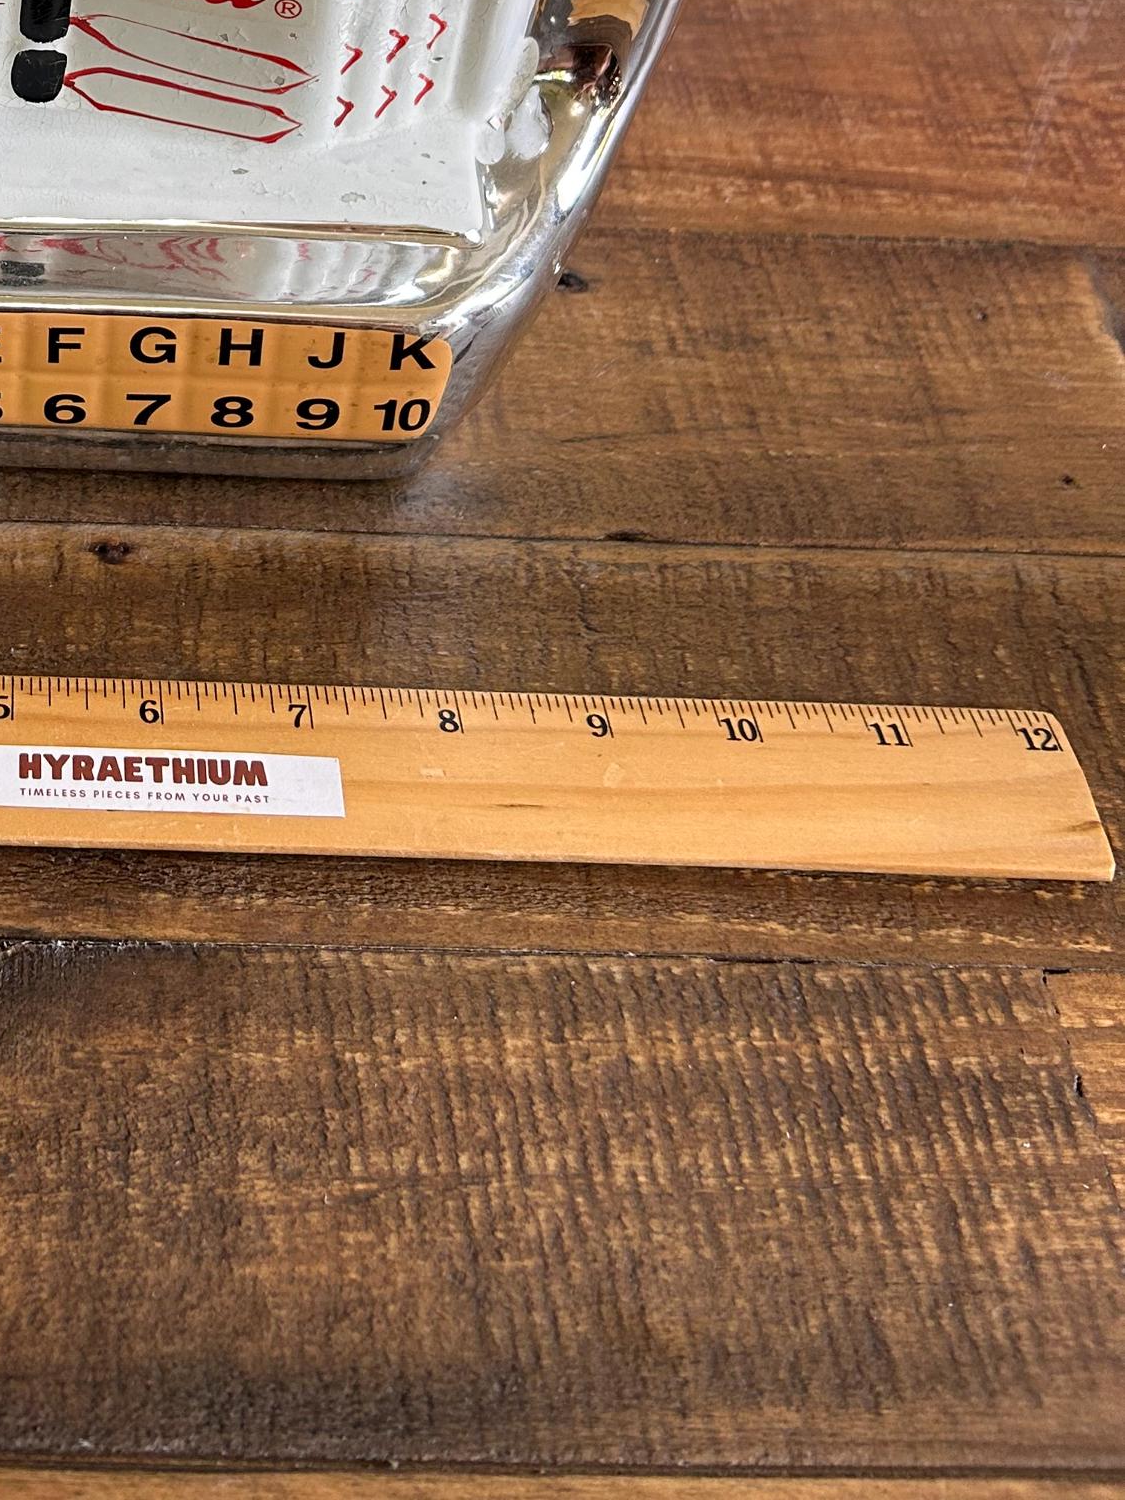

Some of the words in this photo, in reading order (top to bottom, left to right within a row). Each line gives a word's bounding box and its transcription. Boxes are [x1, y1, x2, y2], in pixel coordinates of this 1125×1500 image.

[47, 327, 85, 363] F
[129, 327, 177, 364] G
[218, 328, 264, 366] H
[307, 332, 345, 368] J
[389, 333, 439, 370] K
[43, 394, 86, 424] 6
[125, 394, 171, 425] 7
[210, 396, 254, 428] 8
[296, 398, 340, 430] 9
[374, 399, 431, 431] 10
[139, 699, 160, 724] 6
[288, 704, 307, 728] 7
[438, 709, 460, 733] 8
[586, 713, 608, 737] 9
[720, 717, 758, 742] 10
[869, 723, 909, 746] 11
[1017, 727, 1059, 751] 12
[18, 752, 269, 786] HYRAETHIUM
[20, 787, 87, 798] TIMELESS
[93, 790, 141, 800] PIECES
[147, 791, 186, 801] FROM
[192, 793, 230, 803] YOUR
[235, 794, 271, 804] PAST
